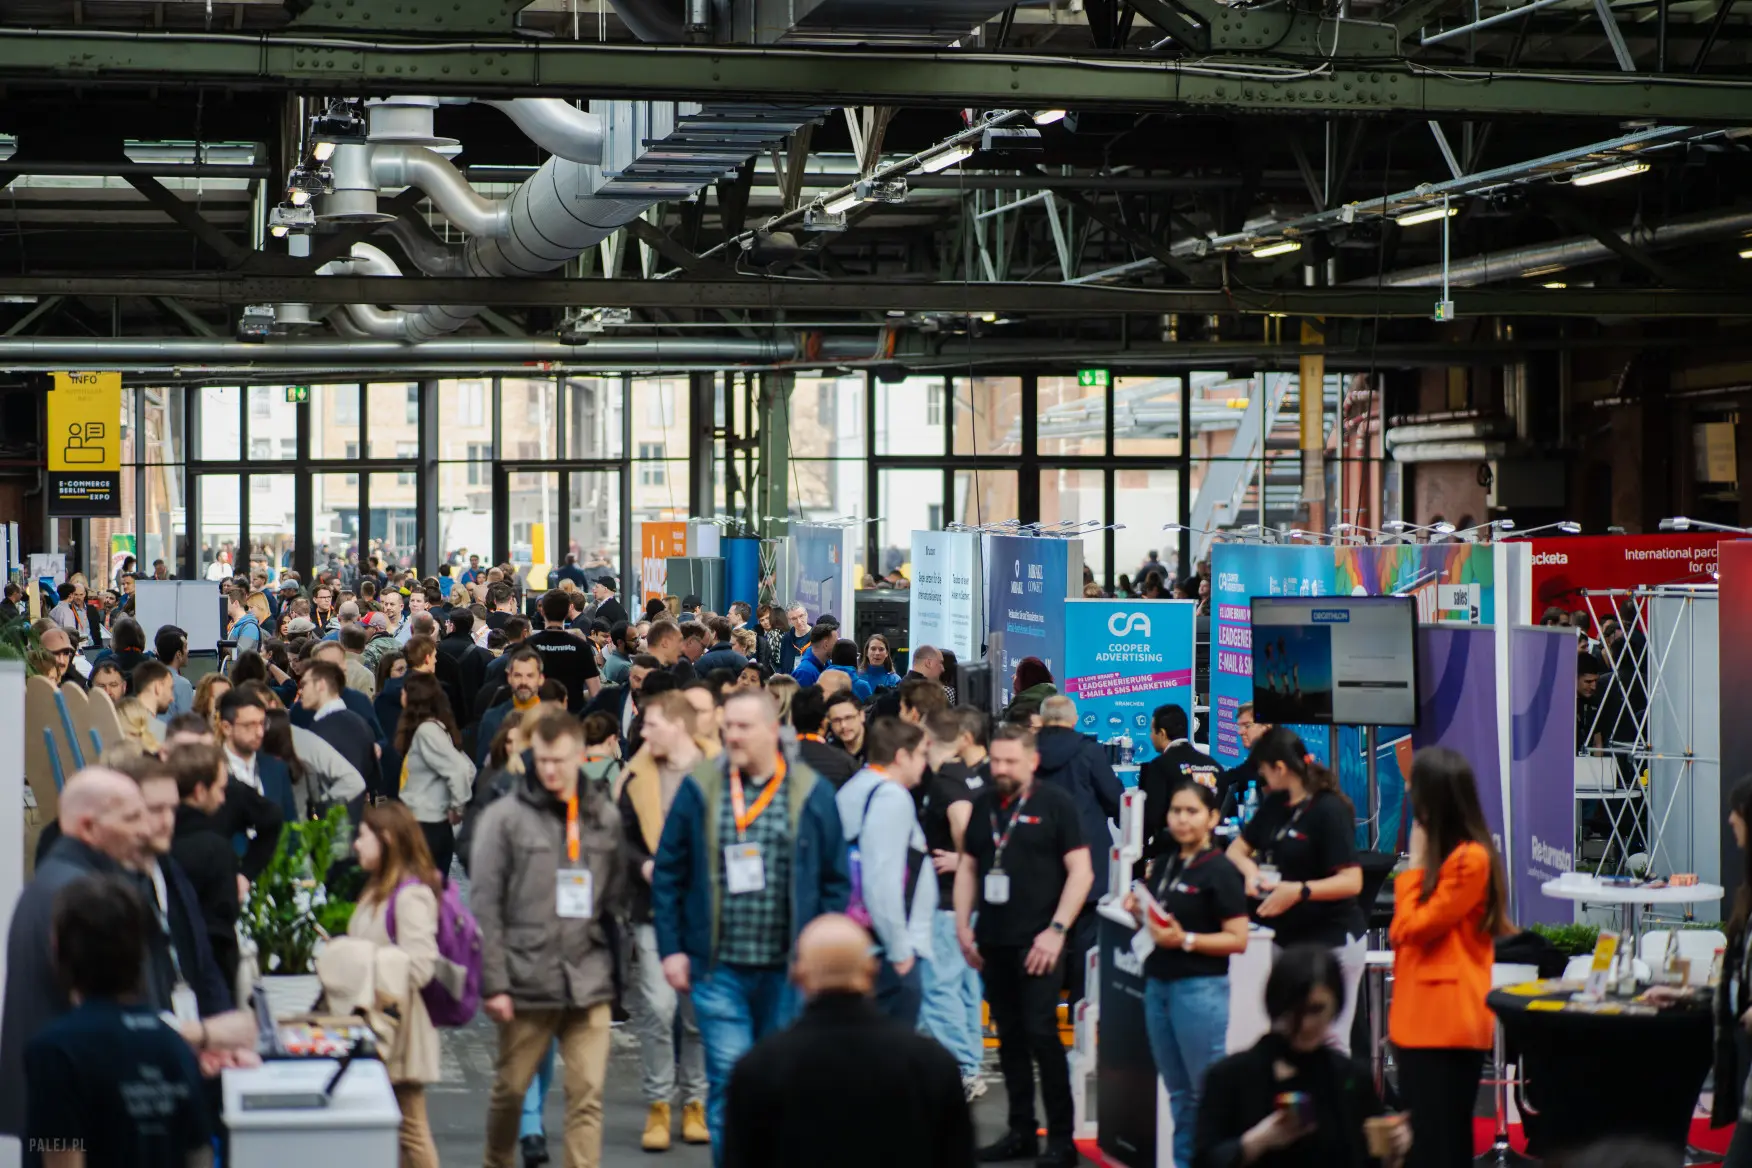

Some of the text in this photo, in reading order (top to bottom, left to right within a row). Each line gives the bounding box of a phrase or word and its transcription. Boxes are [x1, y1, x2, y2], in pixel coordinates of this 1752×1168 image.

[72, 375, 97, 384] INFO
[1625, 547, 1692, 561] International
[1689, 561, 1703, 573] for
[1454, 588, 1467, 606] sales
[1108, 643, 1151, 653] COOPER
[1095, 653, 1163, 662] ADVERTISING
[1218, 652, 1238, 673] E-MAIL
[1239, 655, 1244, 673] &
[1078, 674, 1153, 691] LEADGENERIERUNG
[1097, 673, 1114, 681] BRAND
[1079, 679, 1178, 700] E-MAIL & SMS MARKETING
